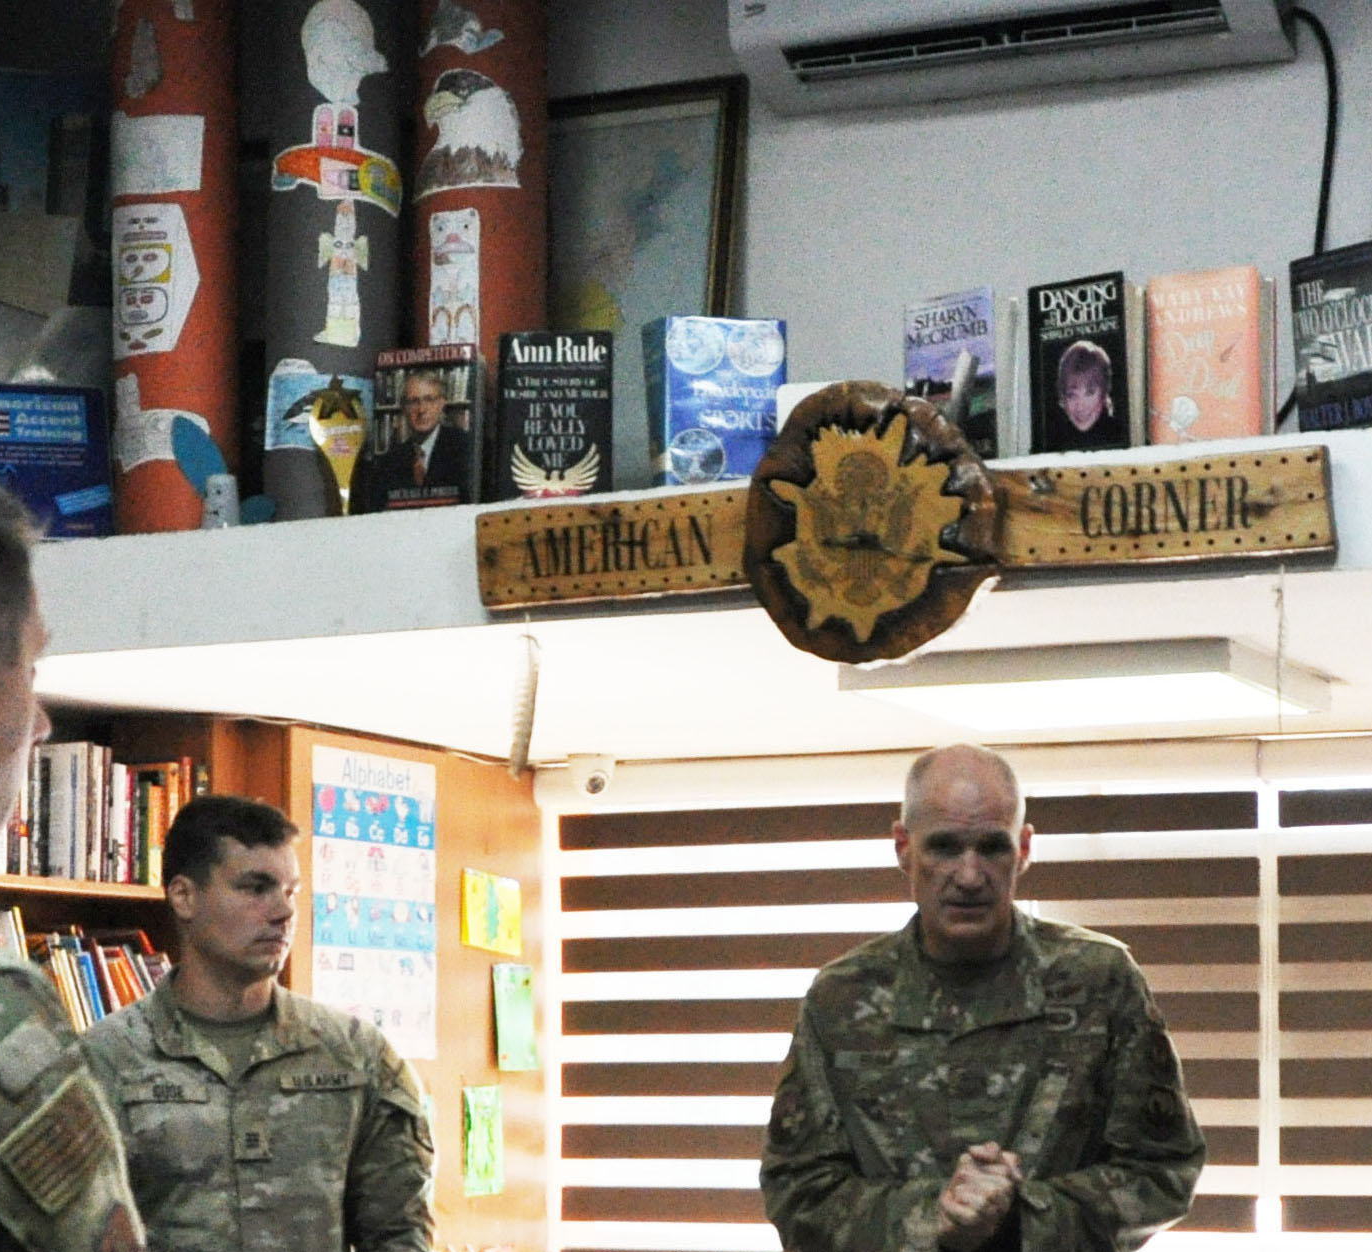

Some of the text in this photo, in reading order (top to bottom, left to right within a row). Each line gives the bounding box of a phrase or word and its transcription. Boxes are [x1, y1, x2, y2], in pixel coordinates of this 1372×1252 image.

[1039, 280, 1118, 313] DANCING
[1297, 278, 1326, 308] THE
[913, 302, 979, 334] SHARYN
[1057, 301, 1107, 326] LIGHT
[1154, 303, 1249, 326] ANDREWS
[906, 319, 989, 348] McCRUMB
[510, 336, 607, 367] Ann Rule
[16, 412, 81, 426] Accent
[529, 402, 576, 419] IF YOU
[16, 426, 83, 442] Training
[524, 419, 586, 436] REALLY
[528, 435, 584, 453] LOVED
[522, 475, 1254, 581] AMERICAN CORNER
[341, 760, 411, 798] Alphabet
